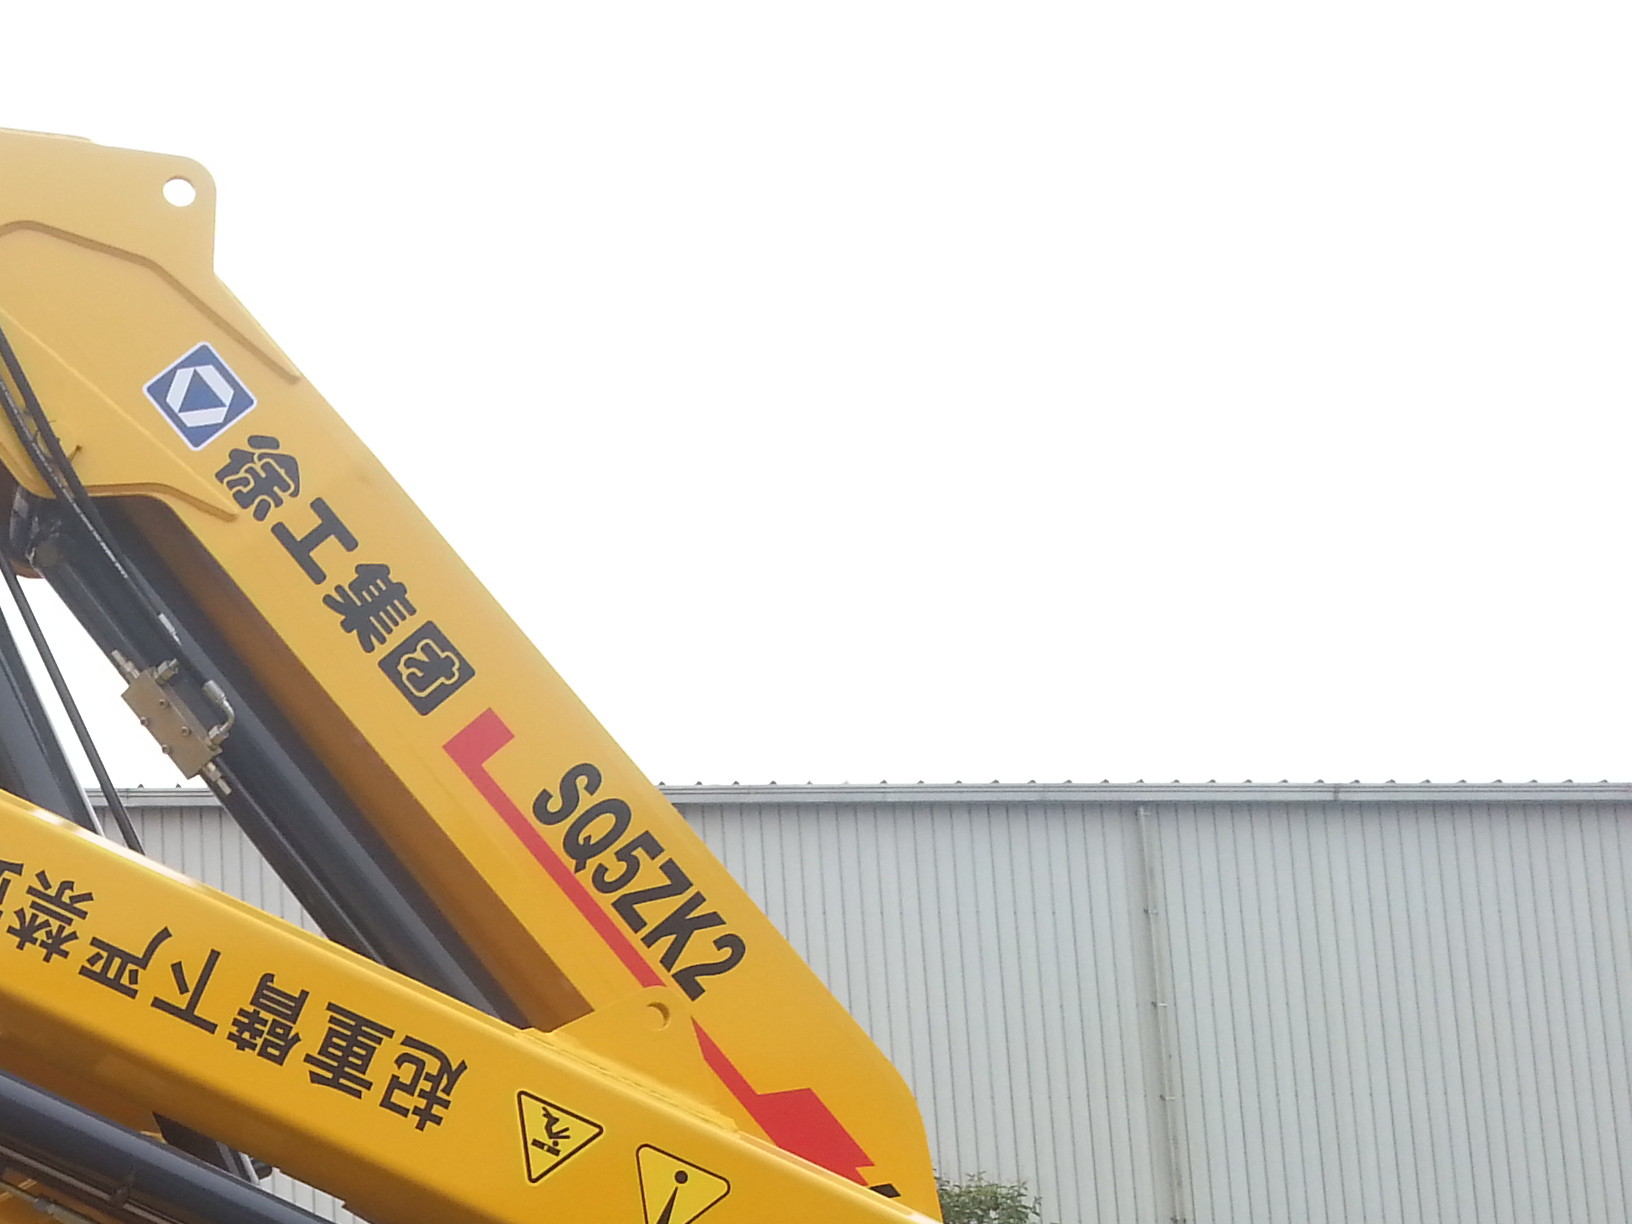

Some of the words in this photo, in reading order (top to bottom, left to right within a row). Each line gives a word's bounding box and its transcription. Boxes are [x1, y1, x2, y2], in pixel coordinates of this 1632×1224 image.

[214, 435, 475, 716] 徐工集团
[531, 761, 747, 1002] SQ5ZK2
